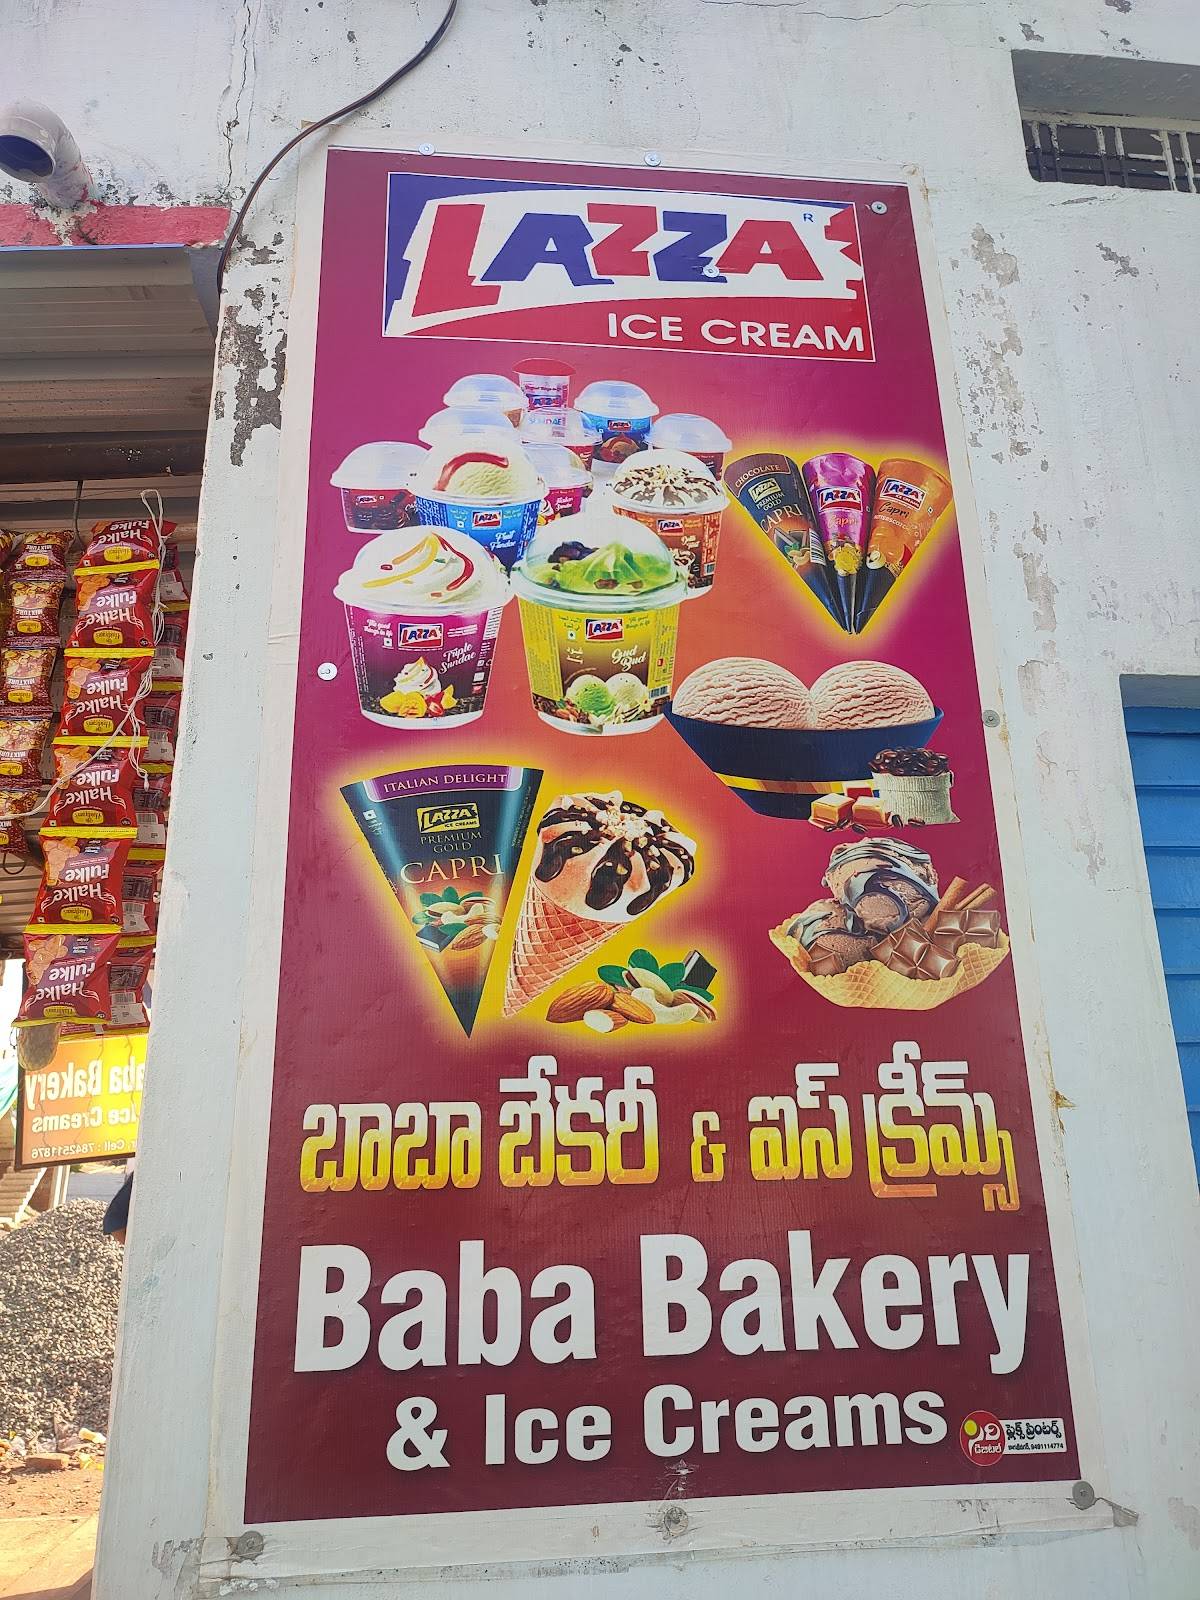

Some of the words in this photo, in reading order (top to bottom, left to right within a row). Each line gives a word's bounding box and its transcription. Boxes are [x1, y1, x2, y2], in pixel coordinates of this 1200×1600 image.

[411, 202, 825, 317] LAZZA
[607, 312, 684, 342] ICE
[701, 318, 865, 352] CREAM
[735, 464, 781, 488] CHOCOLATE
[821, 488, 858, 506] LAZZA
[884, 482, 919, 499] LAZZA
[756, 492, 785, 509] PREMIUM
[763, 499, 782, 511] GOLD
[879, 501, 910, 518] Capri
[474, 513, 498, 526] LAZZA
[659, 520, 682, 531] LAZZA
[760, 503, 804, 534] CAPRI
[98, 529, 141, 544] Halke
[95, 591, 137, 608] Fulke
[86, 608, 131, 625] Halke
[402, 628, 438, 643] LAZZA
[588, 622, 620, 637] LAZZA
[86, 676, 129, 695] Fulke
[76, 695, 122, 714] Halke
[76, 768, 120, 787] Fulke
[383, 775, 439, 794] ITALIAN
[443, 773, 508, 784] DELIGHT
[65, 787, 112, 806] Halke
[422, 807, 473, 831] LAZZA
[420, 832, 483, 845] PREMIUM
[433, 842, 473, 854] GOLD
[65, 863, 110, 883] Fulke
[400, 854, 505, 885] CAPRI
[52, 883, 101, 903] Halke
[35, 981, 85, 1001] Halke
[299, 1101, 482, 1193] బాబా
[498, 1054, 660, 1188] బేకరీ
[747, 1062, 853, 1181] ఐస్
[294, 1239, 598, 1373] Baba
[639, 1229, 1030, 1375] Bakery
[385, 1396, 451, 1472] &
[484, 1394, 612, 1466] Ice
[643, 1384, 948, 1458] Creams
